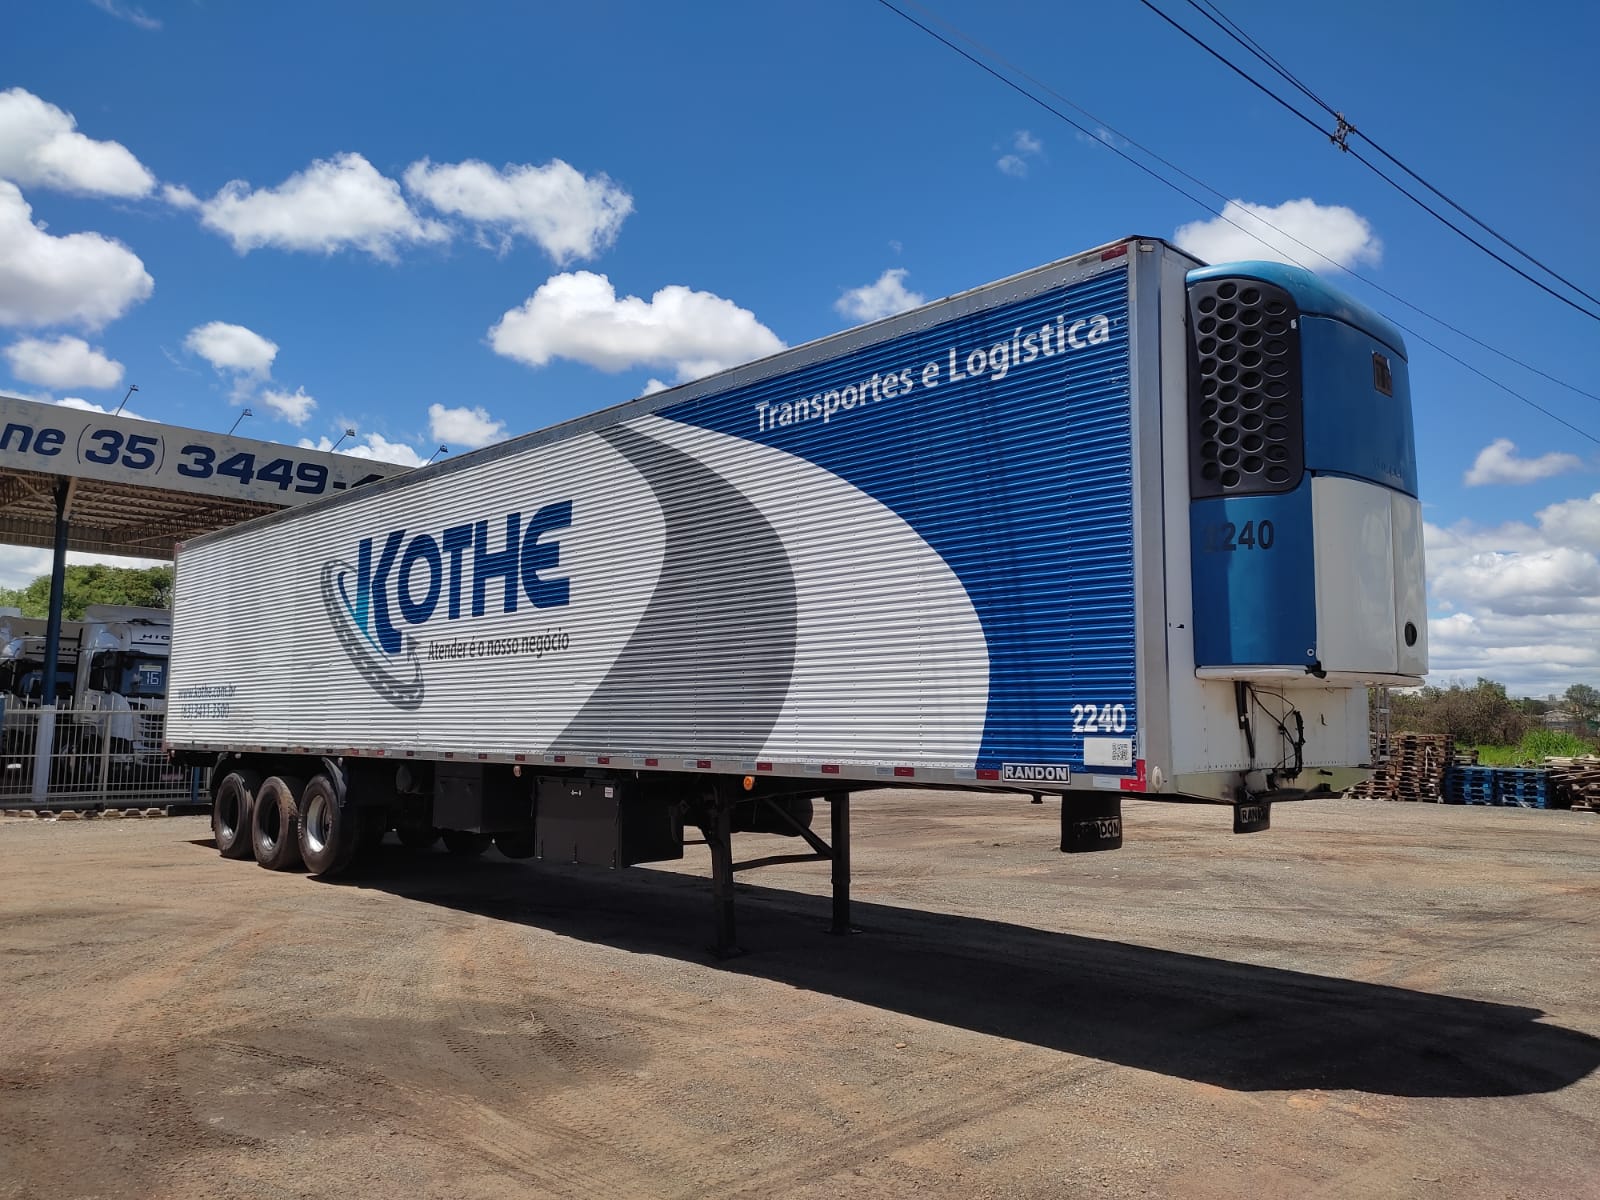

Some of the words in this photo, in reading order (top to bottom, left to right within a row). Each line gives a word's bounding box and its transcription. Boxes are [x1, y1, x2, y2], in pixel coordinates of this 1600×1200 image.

[754, 367, 914, 432] Transportes
[921, 361, 940, 389] e
[949, 313, 1110, 381] Logística
[76, 422, 166, 475] (35)
[1203, 519, 1275, 552] 240
[353, 499, 573, 654] KOTHE
[428, 637, 467, 661] Atender
[469, 635, 476, 658] é
[477, 640, 485, 657] o
[487, 637, 519, 657] nosso
[521, 627, 570, 659] negócio
[1070, 703, 1127, 733] 2240
[1004, 766, 1068, 781] RANDON
